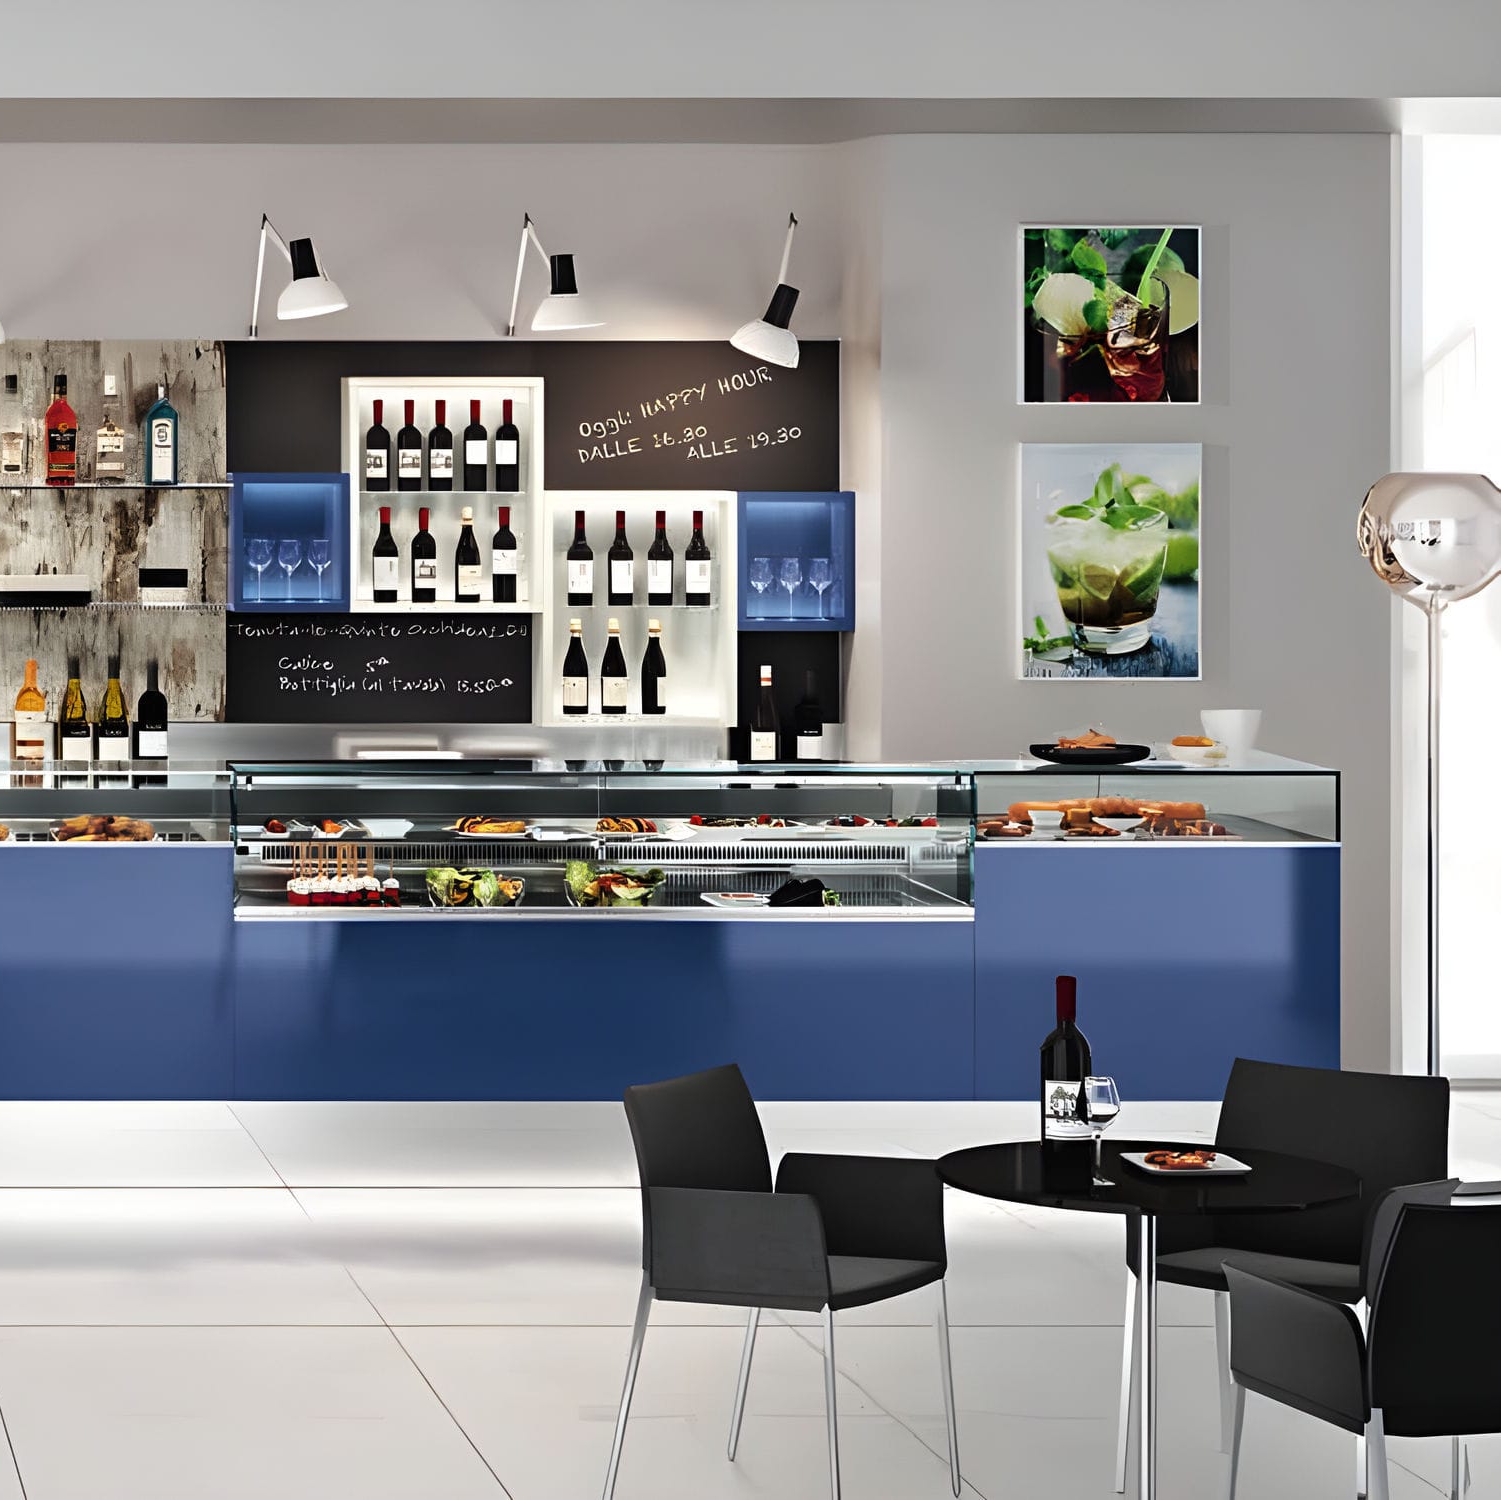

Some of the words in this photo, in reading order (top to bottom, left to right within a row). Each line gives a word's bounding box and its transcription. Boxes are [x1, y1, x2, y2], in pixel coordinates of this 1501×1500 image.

[717, 366, 773, 395] HOUR
[578, 437, 643, 464] DALLE
[687, 437, 739, 459] ALLE
